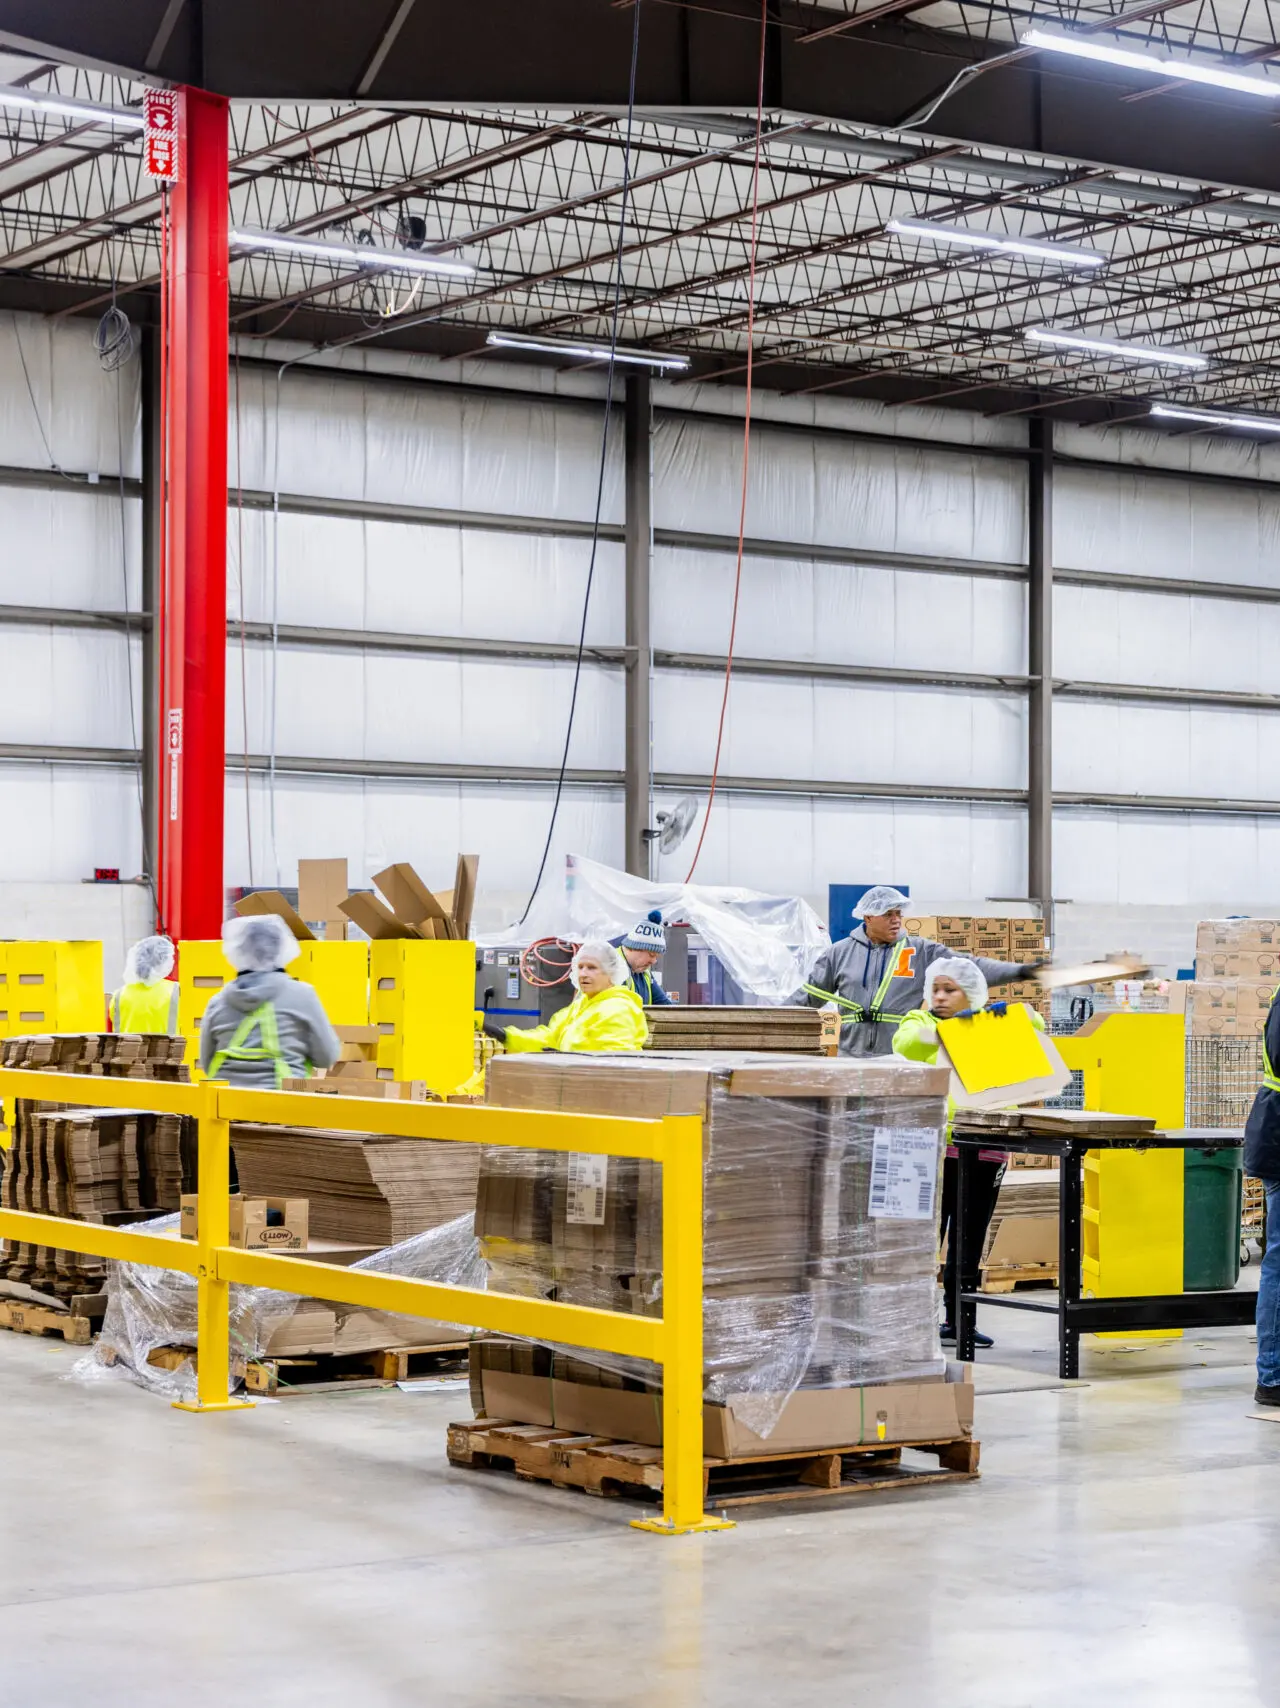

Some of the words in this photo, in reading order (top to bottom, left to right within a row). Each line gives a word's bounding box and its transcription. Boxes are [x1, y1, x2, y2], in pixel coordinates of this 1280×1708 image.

[149, 94, 171, 106] FIRE
[635, 924, 663, 938] COW
[263, 1232, 289, 1243] MOTT'S
